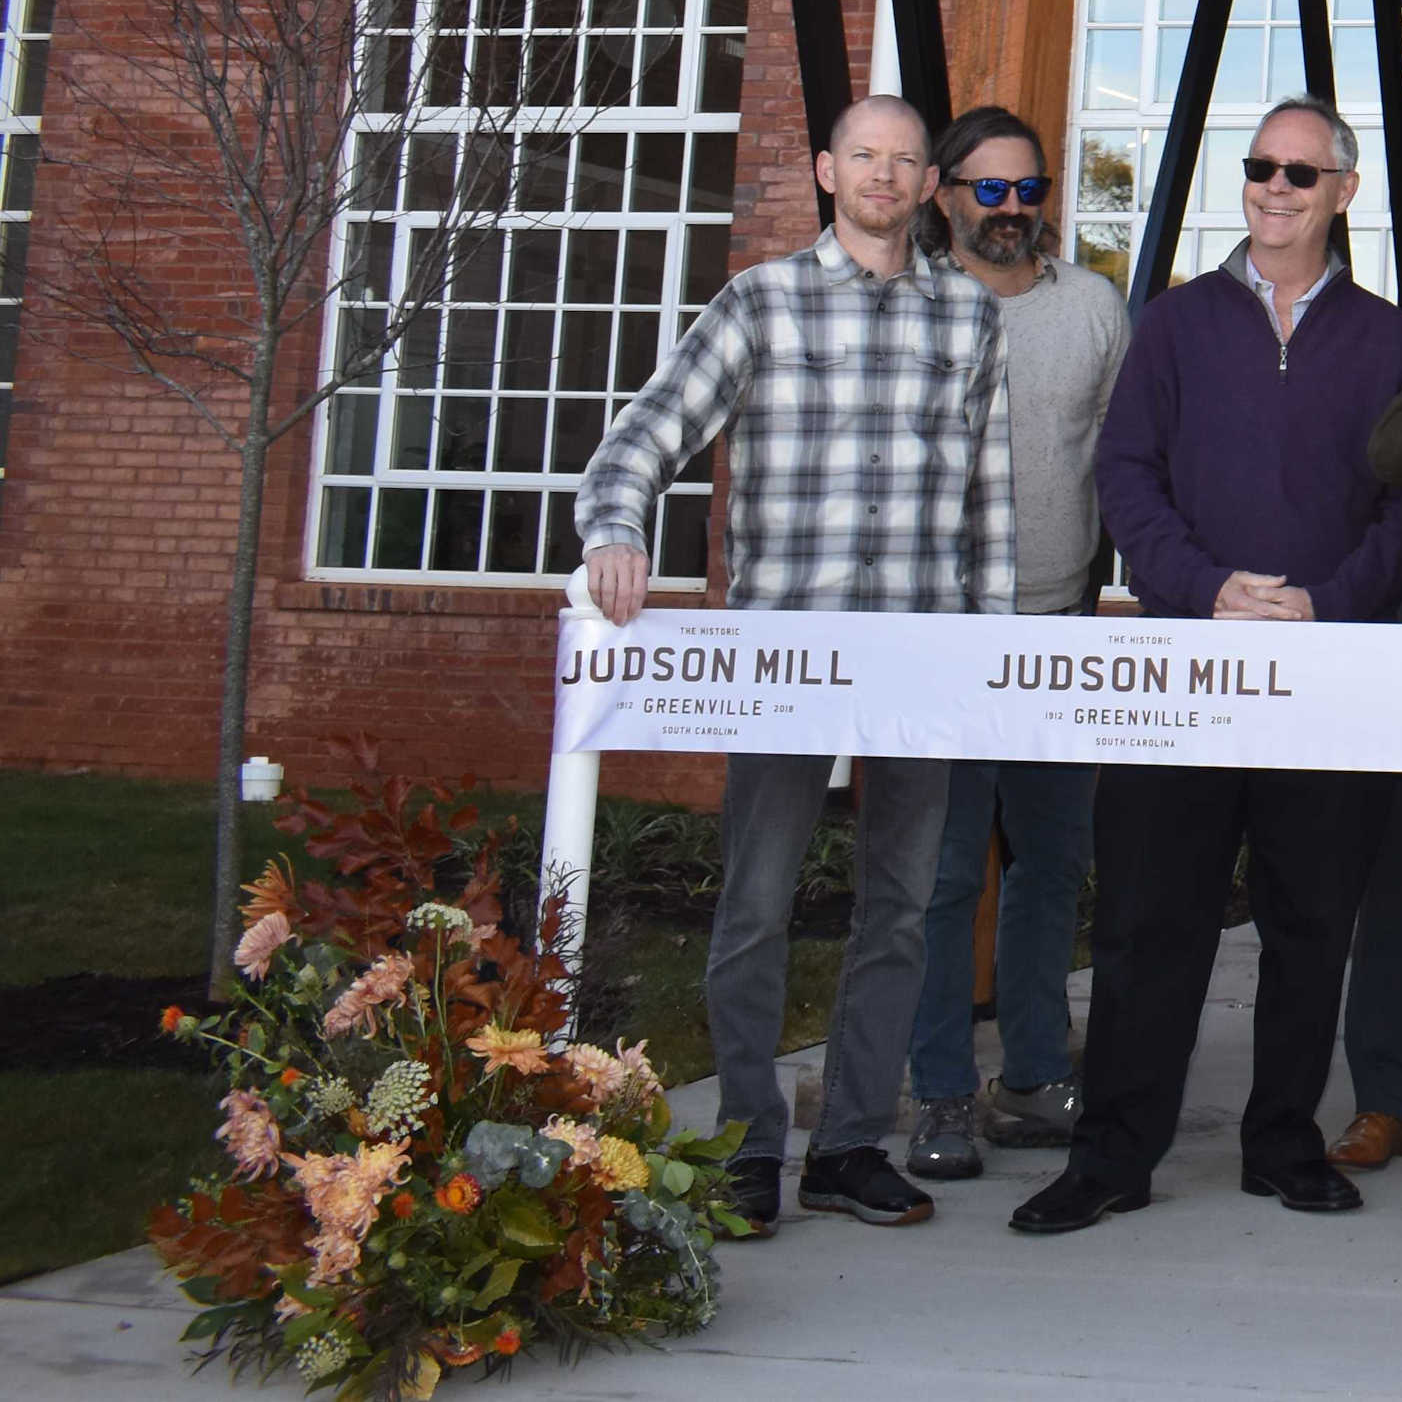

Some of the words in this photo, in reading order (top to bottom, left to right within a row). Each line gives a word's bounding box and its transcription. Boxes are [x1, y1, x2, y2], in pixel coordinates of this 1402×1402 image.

[679, 627, 697, 636] THE
[699, 628, 741, 637] HISTORIC
[1107, 635, 1126, 645] THE
[1129, 636, 1173, 646] HISTORIC
[561, 647, 738, 686] JUDSON
[754, 648, 853, 686] MILL
[986, 654, 1169, 694] JUDSON
[1189, 658, 1293, 697] MILL
[643, 698, 764, 717] GREENVILLE
[773, 705, 795, 714] 2018
[1044, 712, 1064, 721] 1912
[1074, 708, 1200, 728] GREENVILLE
[1210, 716, 1233, 725] 2018
[661, 727, 692, 736] SOUTH
[694, 727, 739, 737] CAROLINA
[1095, 737, 1126, 747] SOUTH
[1129, 738, 1177, 749] CAROLINA
